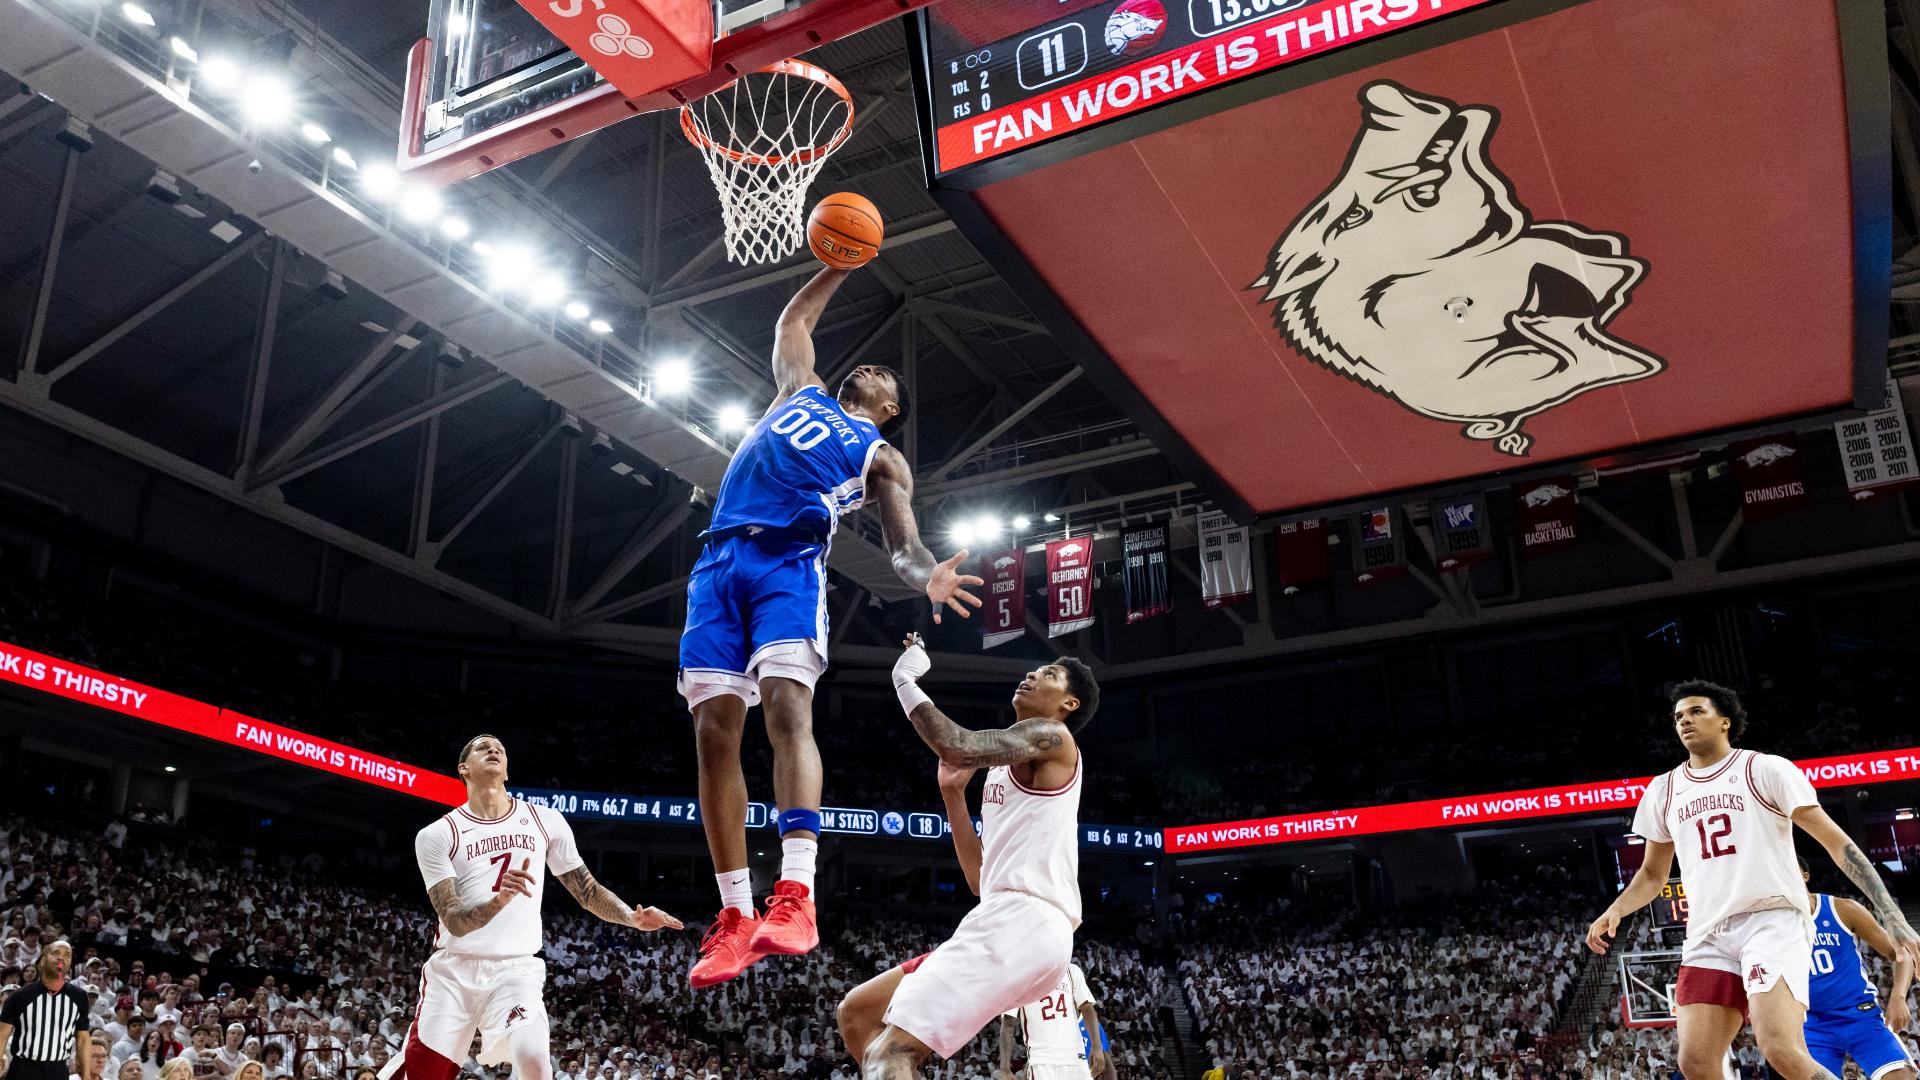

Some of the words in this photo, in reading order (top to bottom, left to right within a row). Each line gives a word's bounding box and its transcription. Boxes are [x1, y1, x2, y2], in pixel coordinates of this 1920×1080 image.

[1038, 33, 1066, 77] 11
[951, 61, 958, 74] B
[951, 80, 970, 97] TOL
[980, 71, 990, 90] 2
[972, 101, 1052, 154] FAN
[1061, 51, 1206, 123] WORK
[1215, 35, 1259, 75] IS
[953, 101, 971, 119] FLS
[981, 93, 991, 112] 0
[771, 408, 831, 451] 00
[788, 396, 861, 447] KENTUCKY
[1842, 422, 1867, 437] 2004
[1874, 415, 1900, 432] 2005
[1846, 437, 1871, 453] 2006
[1878, 431, 1902, 447] 2007
[1850, 452, 1874, 468] 2008
[1882, 446, 1907, 462] 2009
[1854, 467, 1877, 483] 2010
[1887, 461, 1909, 477] 2011
[1745, 481, 1804, 504] GYMNASTICS
[1125, 527, 1165, 544] CONFERENCE
[1201, 519, 1220, 530] SWEET
[1525, 524, 1576, 546] BASKETBALL
[1125, 538, 1165, 552] CHAMPIONSHIPS
[1227, 531, 1242, 544] 1991
[1128, 555, 1144, 568] 1990
[1149, 552, 1164, 565] 1991
[1363, 543, 1395, 566] 1998
[993, 580, 1015, 594] FISCUS
[1052, 567, 1088, 584] DEHORNEY
[1059, 585, 1084, 618] 50
[999, 599, 1011, 628] 5
[25, 660, 46, 680] IS
[52, 666, 147, 709] THIRSTY
[235, 722, 272, 747] FAN
[276, 734, 328, 763] WORK
[330, 750, 345, 768] IS
[349, 755, 416, 788] THIRSTY
[1801, 762, 1866, 781] WORK
[1870, 760, 1890, 775] IS
[552, 794, 578, 813] 20.0
[582, 799, 600, 812] FT%
[602, 798, 628, 816] 66.7
[634, 802, 647, 815] REB
[651, 800, 661, 818] 4
[669, 804, 682, 817] AST
[686, 803, 696, 821] 2
[1442, 803, 1479, 819] FAN
[1483, 796, 1541, 815] WORK
[1544, 794, 1562, 809] IS
[1677, 793, 1745, 824] RAZORBACKS
[838, 813, 874, 831] STATS
[918, 817, 933, 835] 18
[1176, 832, 1208, 846] FAN
[1212, 826, 1261, 842] WORK
[1264, 824, 1280, 837] IS
[1283, 815, 1358, 835] THIRSTY
[466, 834, 536, 861] RAZORBACKS
[1087, 830, 1100, 842] REB
[1103, 829, 1111, 846] 6
[1117, 833, 1128, 844] AST
[1134, 830, 1143, 848] 2
[1154, 832, 1162, 849] 0
[1696, 813, 1737, 860] 12
[489, 852, 512, 893] 7
[1039, 993, 1068, 1021] 24
